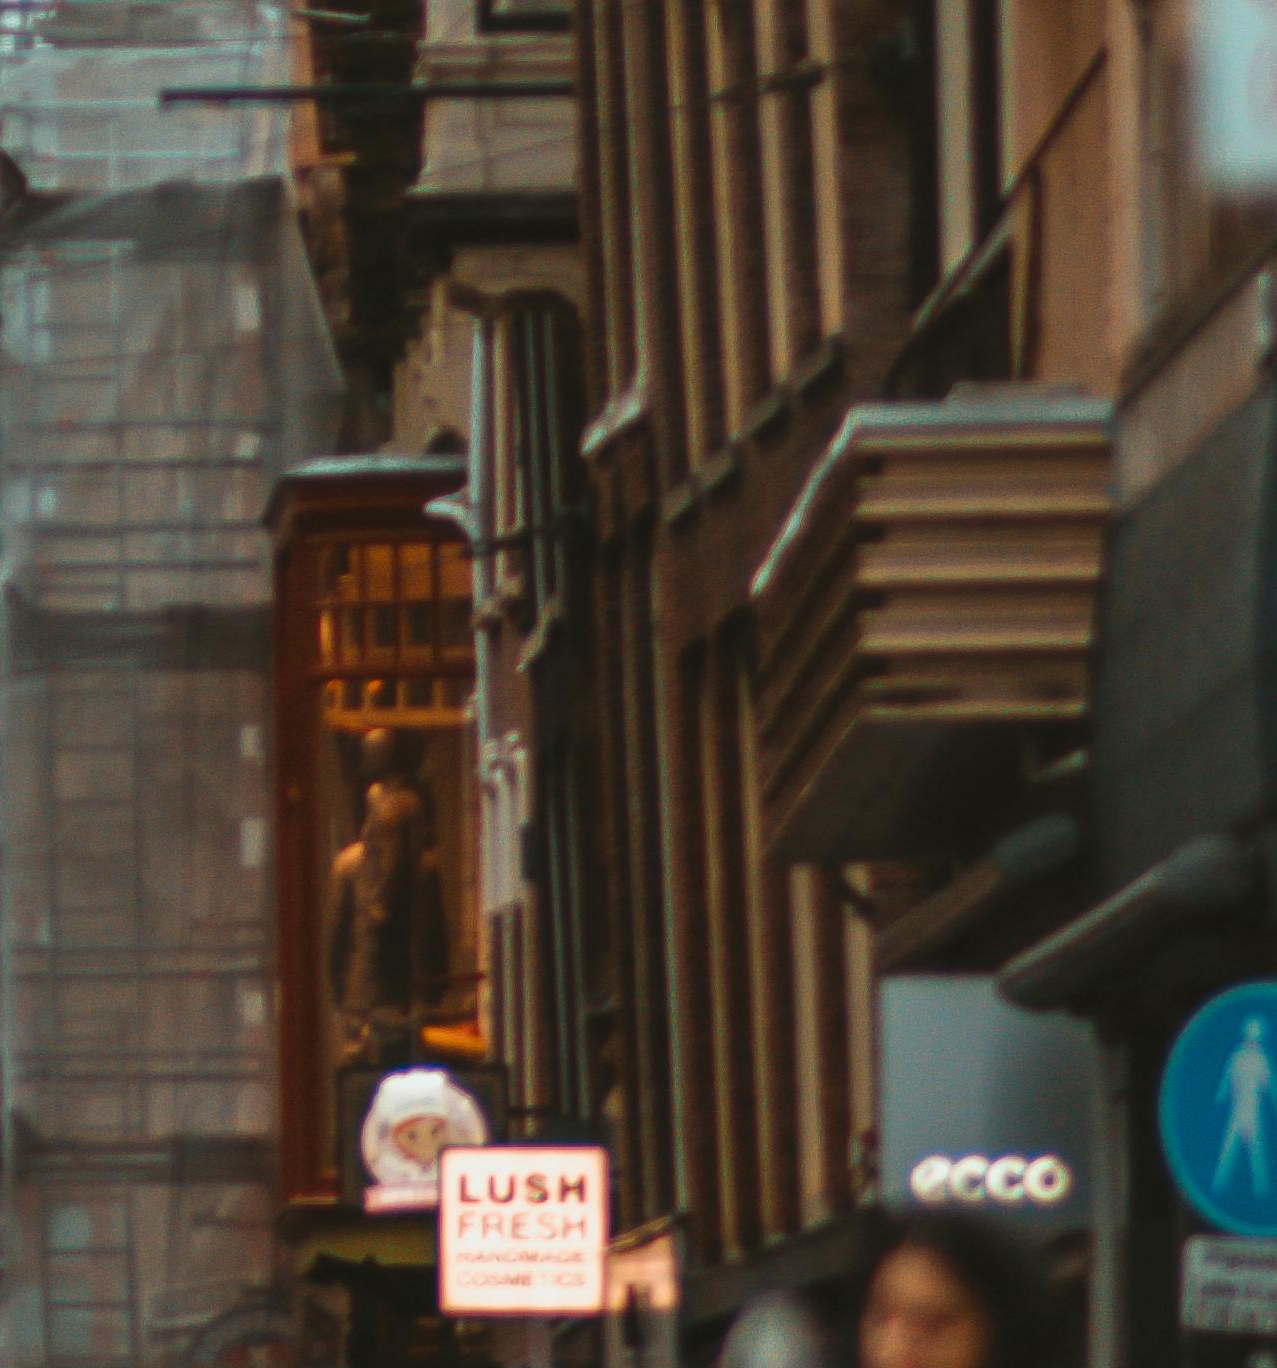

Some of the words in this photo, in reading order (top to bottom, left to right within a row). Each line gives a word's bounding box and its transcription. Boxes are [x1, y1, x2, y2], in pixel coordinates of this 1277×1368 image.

[459, 1174, 586, 1204] LUSH
[911, 1154, 1071, 1203] ecco
[458, 1210, 586, 1240] FRESH
